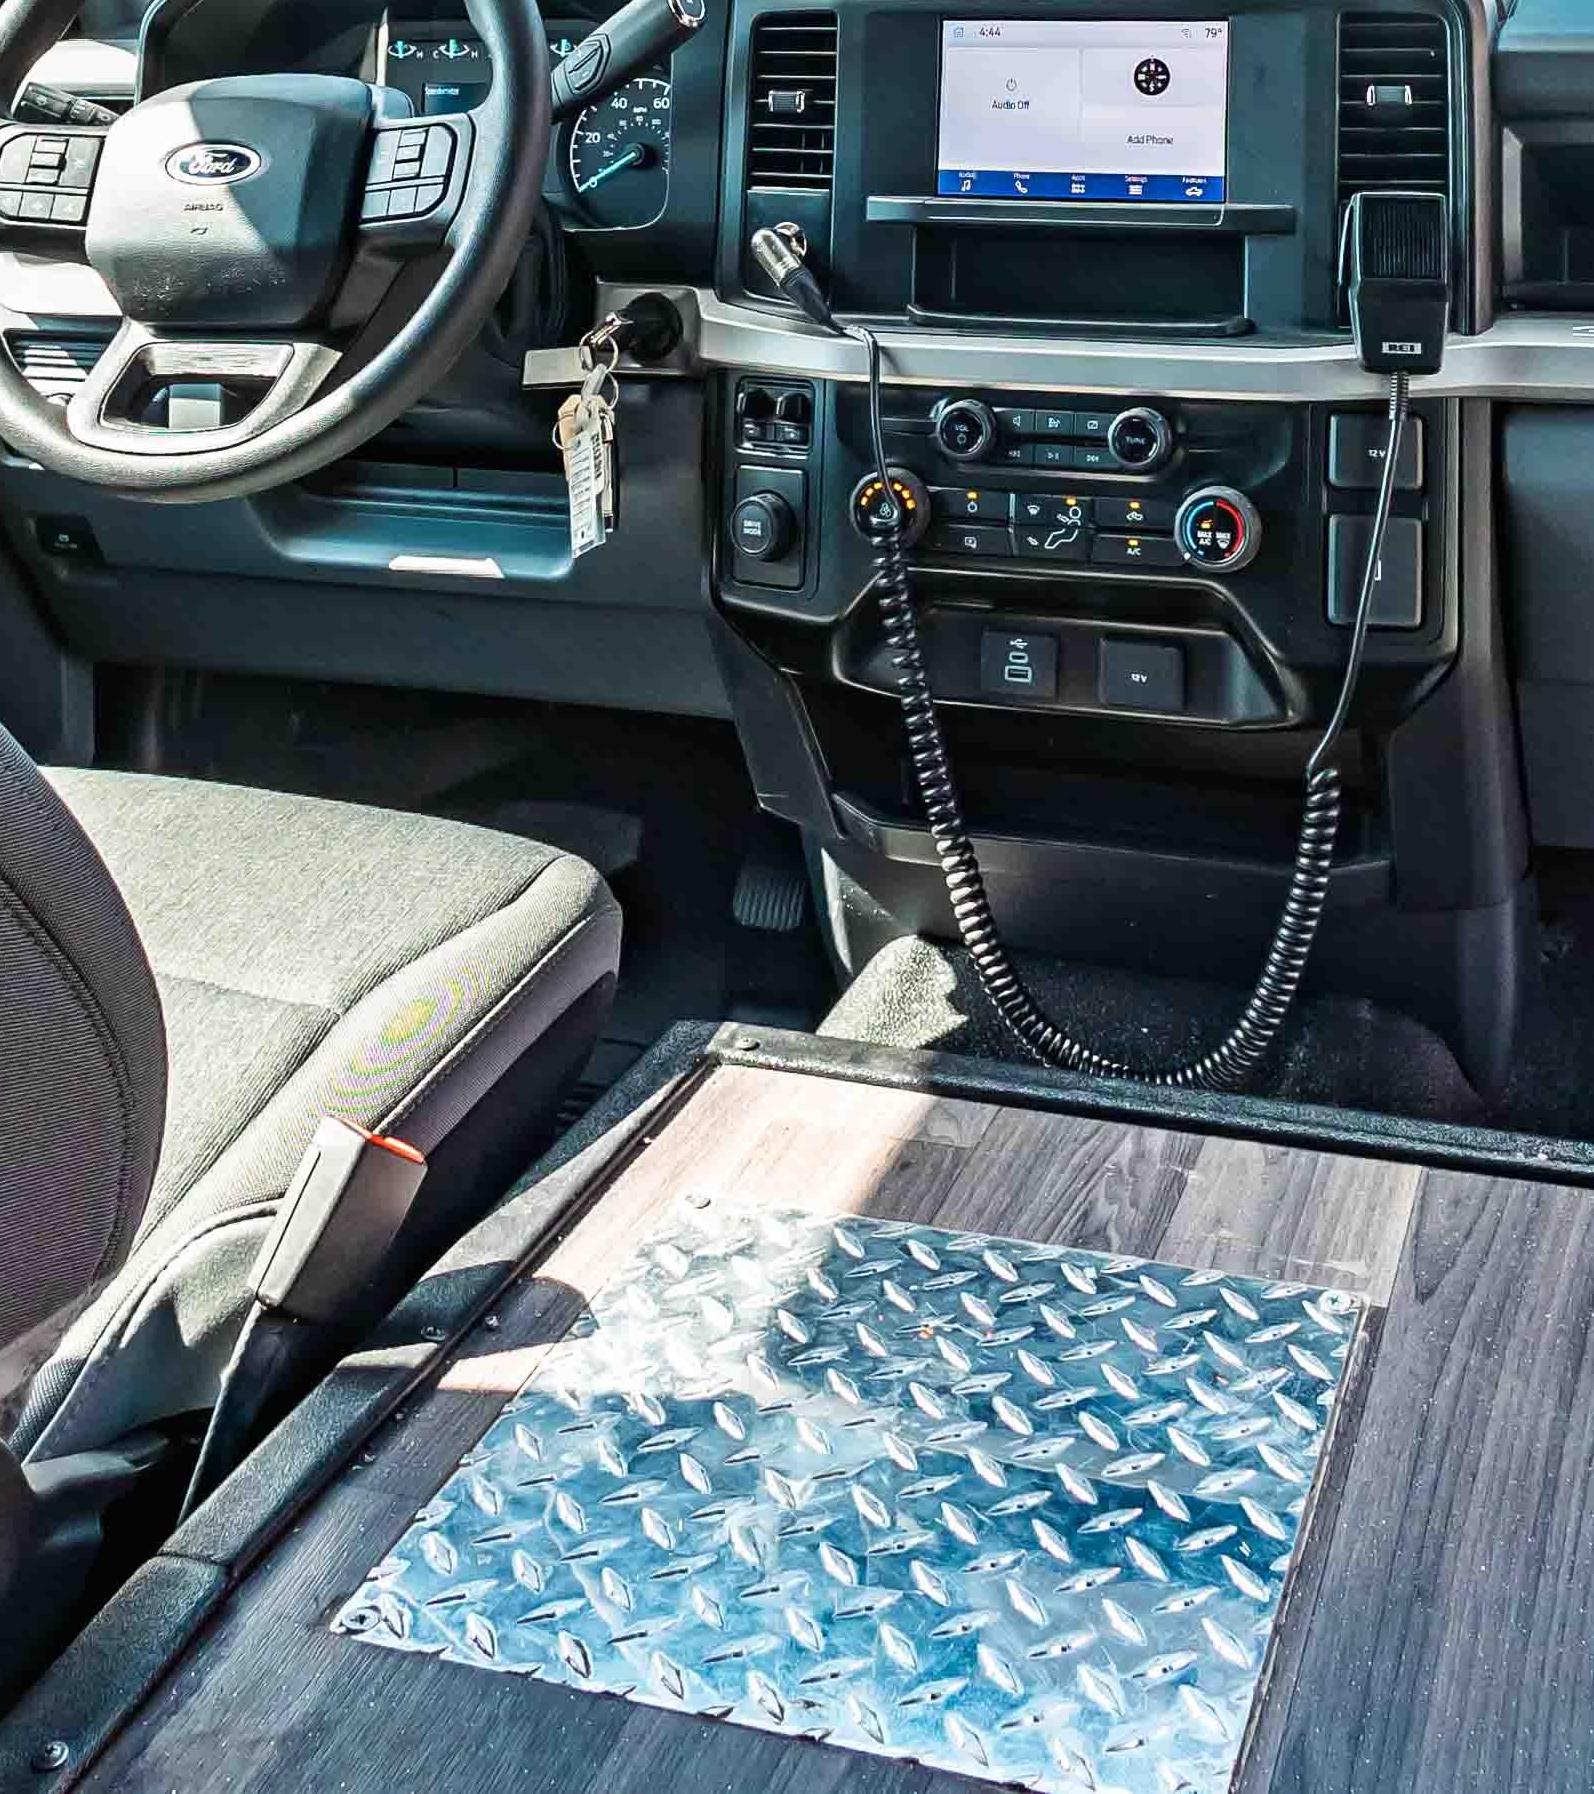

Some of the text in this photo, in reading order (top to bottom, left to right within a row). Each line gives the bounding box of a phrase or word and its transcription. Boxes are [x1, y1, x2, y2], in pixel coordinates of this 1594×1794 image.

[979, 27, 1001, 37] 4:44
[611, 98, 628, 109] 40
[653, 98, 670, 109] 60
[992, 100, 1029, 110] Audio Off
[585, 132, 601, 143] 20
[1127, 135, 1173, 145] Add Phone
[189, 151, 238, 174] Ford
[183, 203, 223, 211] AIRBAG
[955, 424, 969, 432] VOL
[1125, 436, 1145, 445] TUNE
